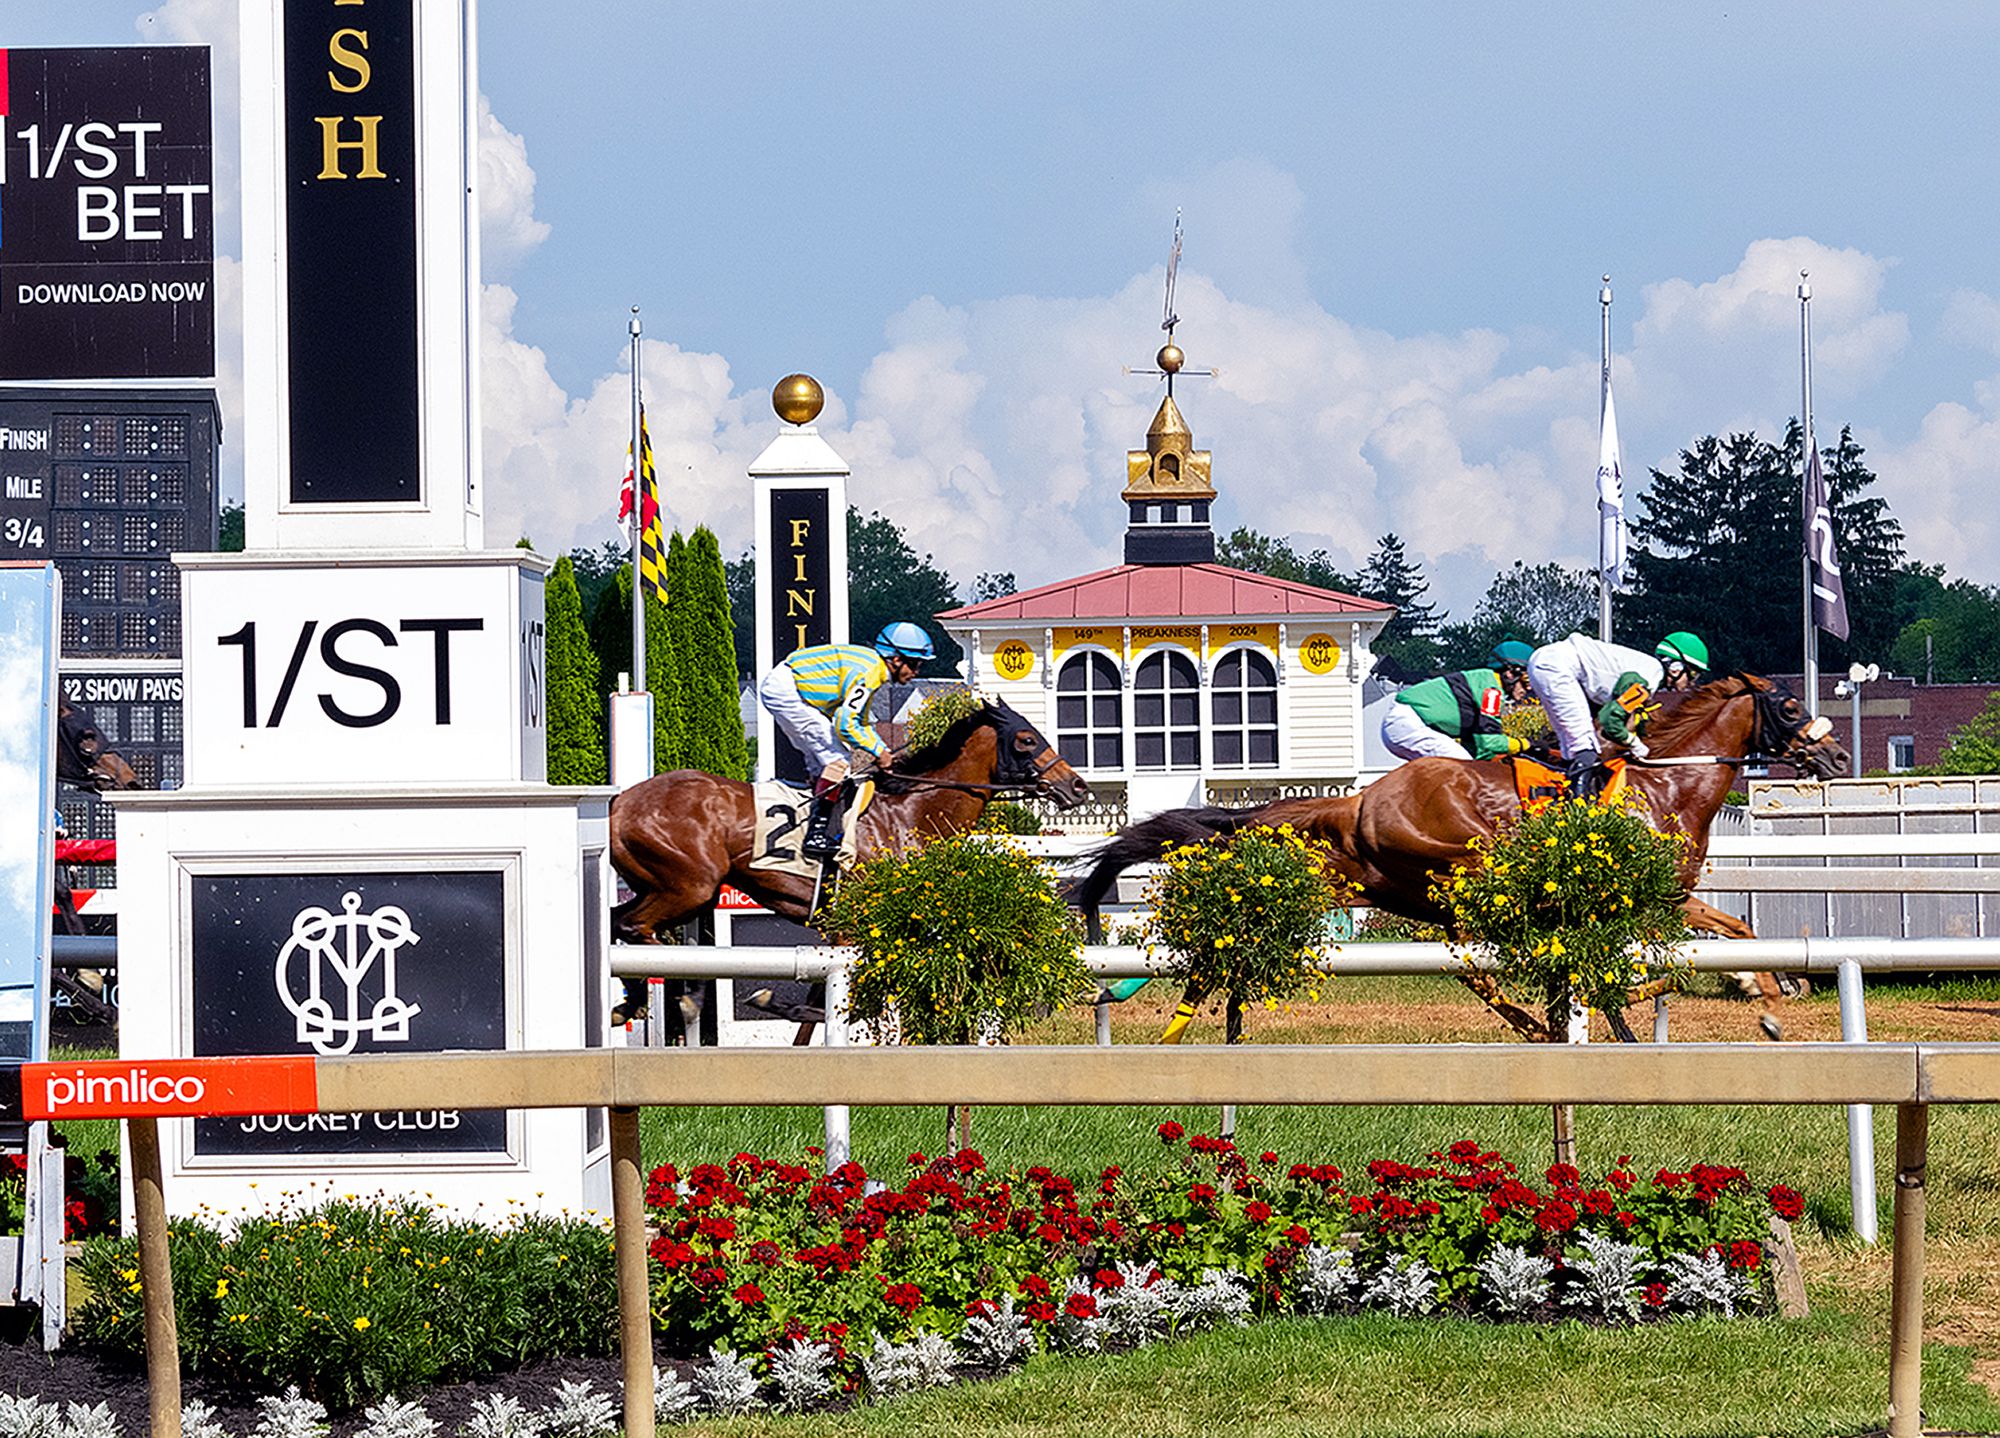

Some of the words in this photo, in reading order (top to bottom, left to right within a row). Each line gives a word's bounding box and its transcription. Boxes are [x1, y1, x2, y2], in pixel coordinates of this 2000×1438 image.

[313, 0, 387, 180] SH
[16, 121, 163, 179] 1/ST
[77, 184, 210, 241] BET
[18, 283, 147, 304] DOWNLOAD
[151, 282, 206, 302] NOW
[0, 428, 48, 450] FINISH
[6, 476, 42, 499] MILE
[4, 518, 45, 548] 3/4
[786, 519, 816, 651] FINI
[1131, 627, 1200, 638] PREAKNESS
[1229, 626, 1258, 637] 2024
[217, 617, 484, 729] 1/ST
[64, 678, 82, 701] $2
[85, 678, 138, 701] SHOW
[142, 678, 183, 701] PAYS
[848, 688, 865, 710] 2
[1486, 687, 1498, 713] 1
[1623, 688, 1644, 706] 7
[765, 804, 797, 861] 2
[46, 1069, 205, 1113] pimlico
[240, 1112, 363, 1133] JOCKEY
[373, 1109, 460, 1130] CLUB
